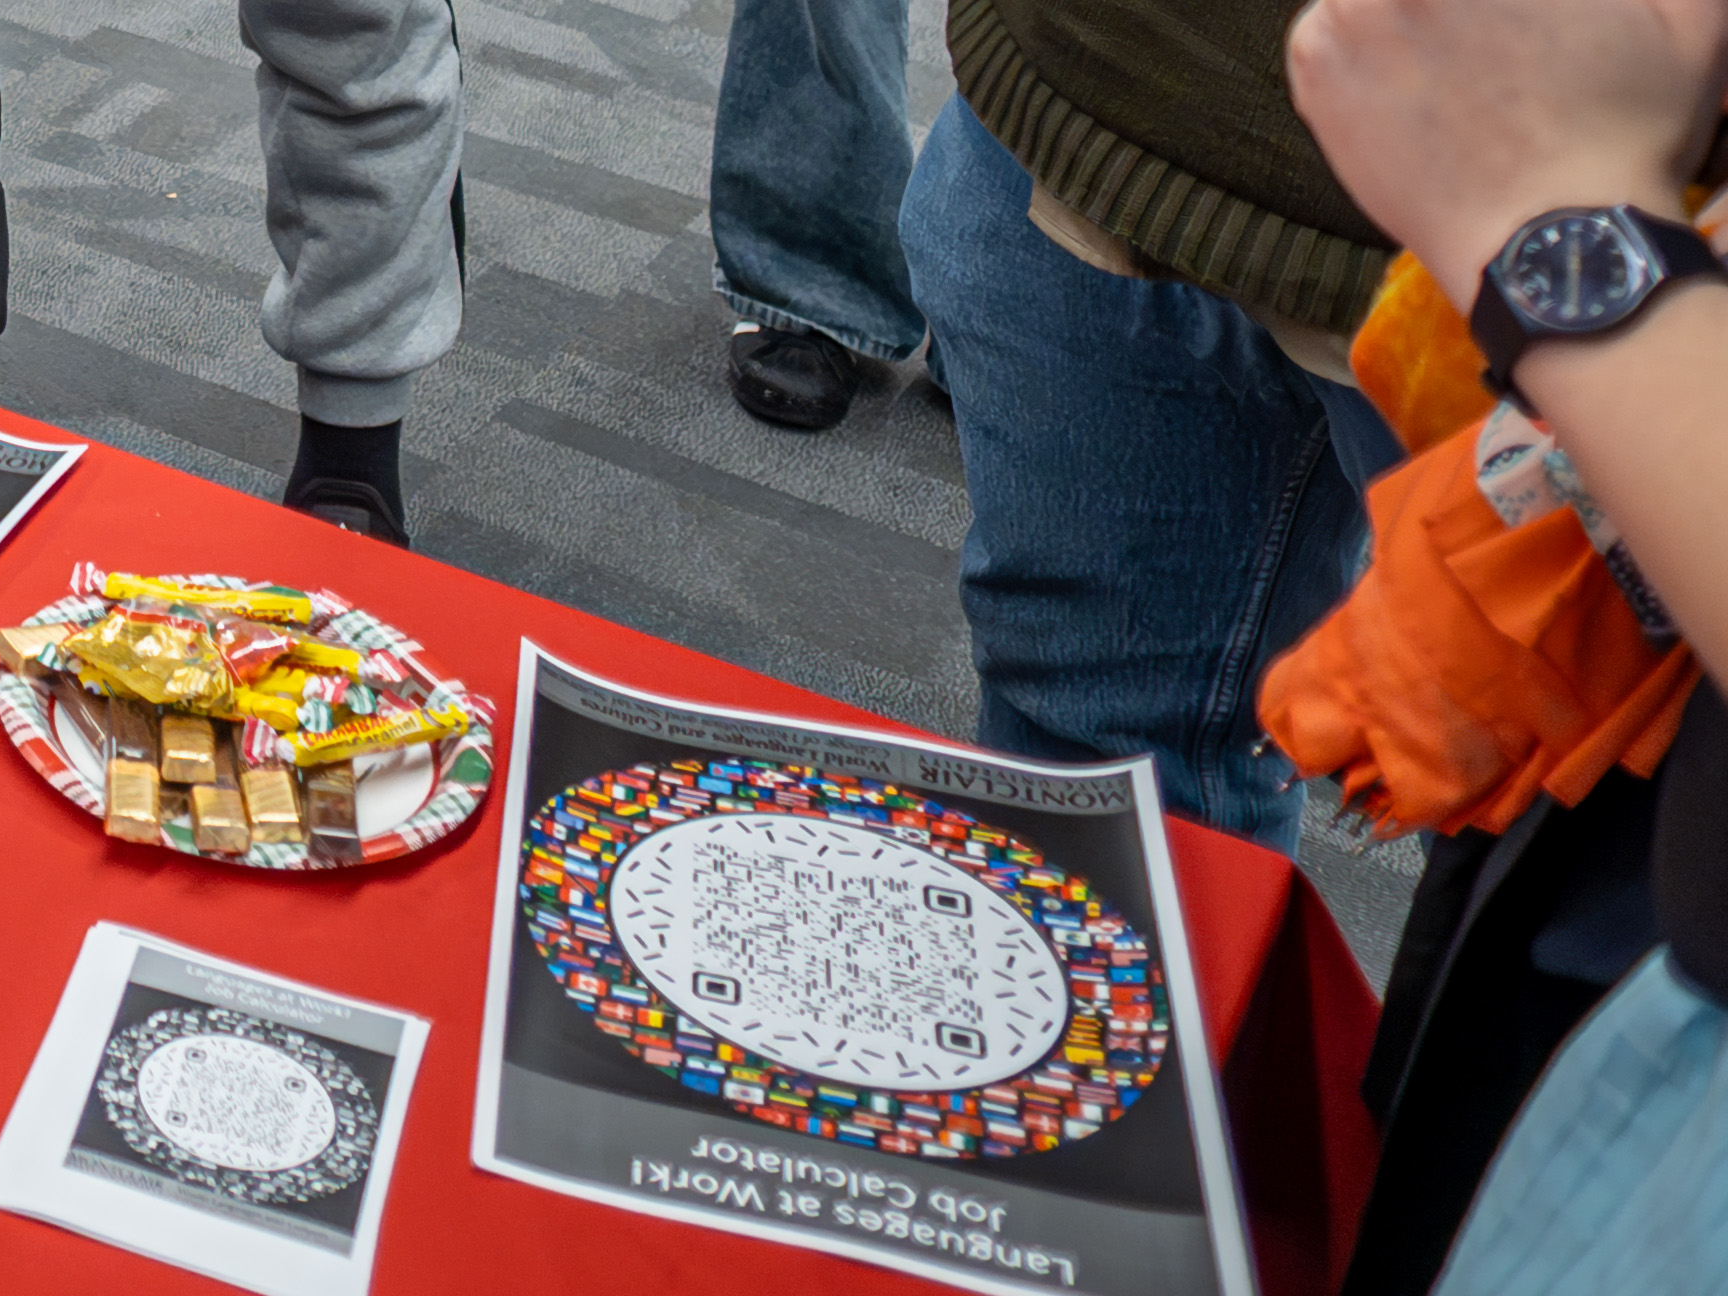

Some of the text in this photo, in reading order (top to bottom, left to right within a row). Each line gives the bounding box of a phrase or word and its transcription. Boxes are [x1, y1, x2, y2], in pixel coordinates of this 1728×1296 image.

[580, 697, 1130, 809] MONTCLAIR World Languages and Cultures
[630, 1155, 1075, 1286] Languages at Work!
[690, 1135, 1008, 1233] Job Calculator
